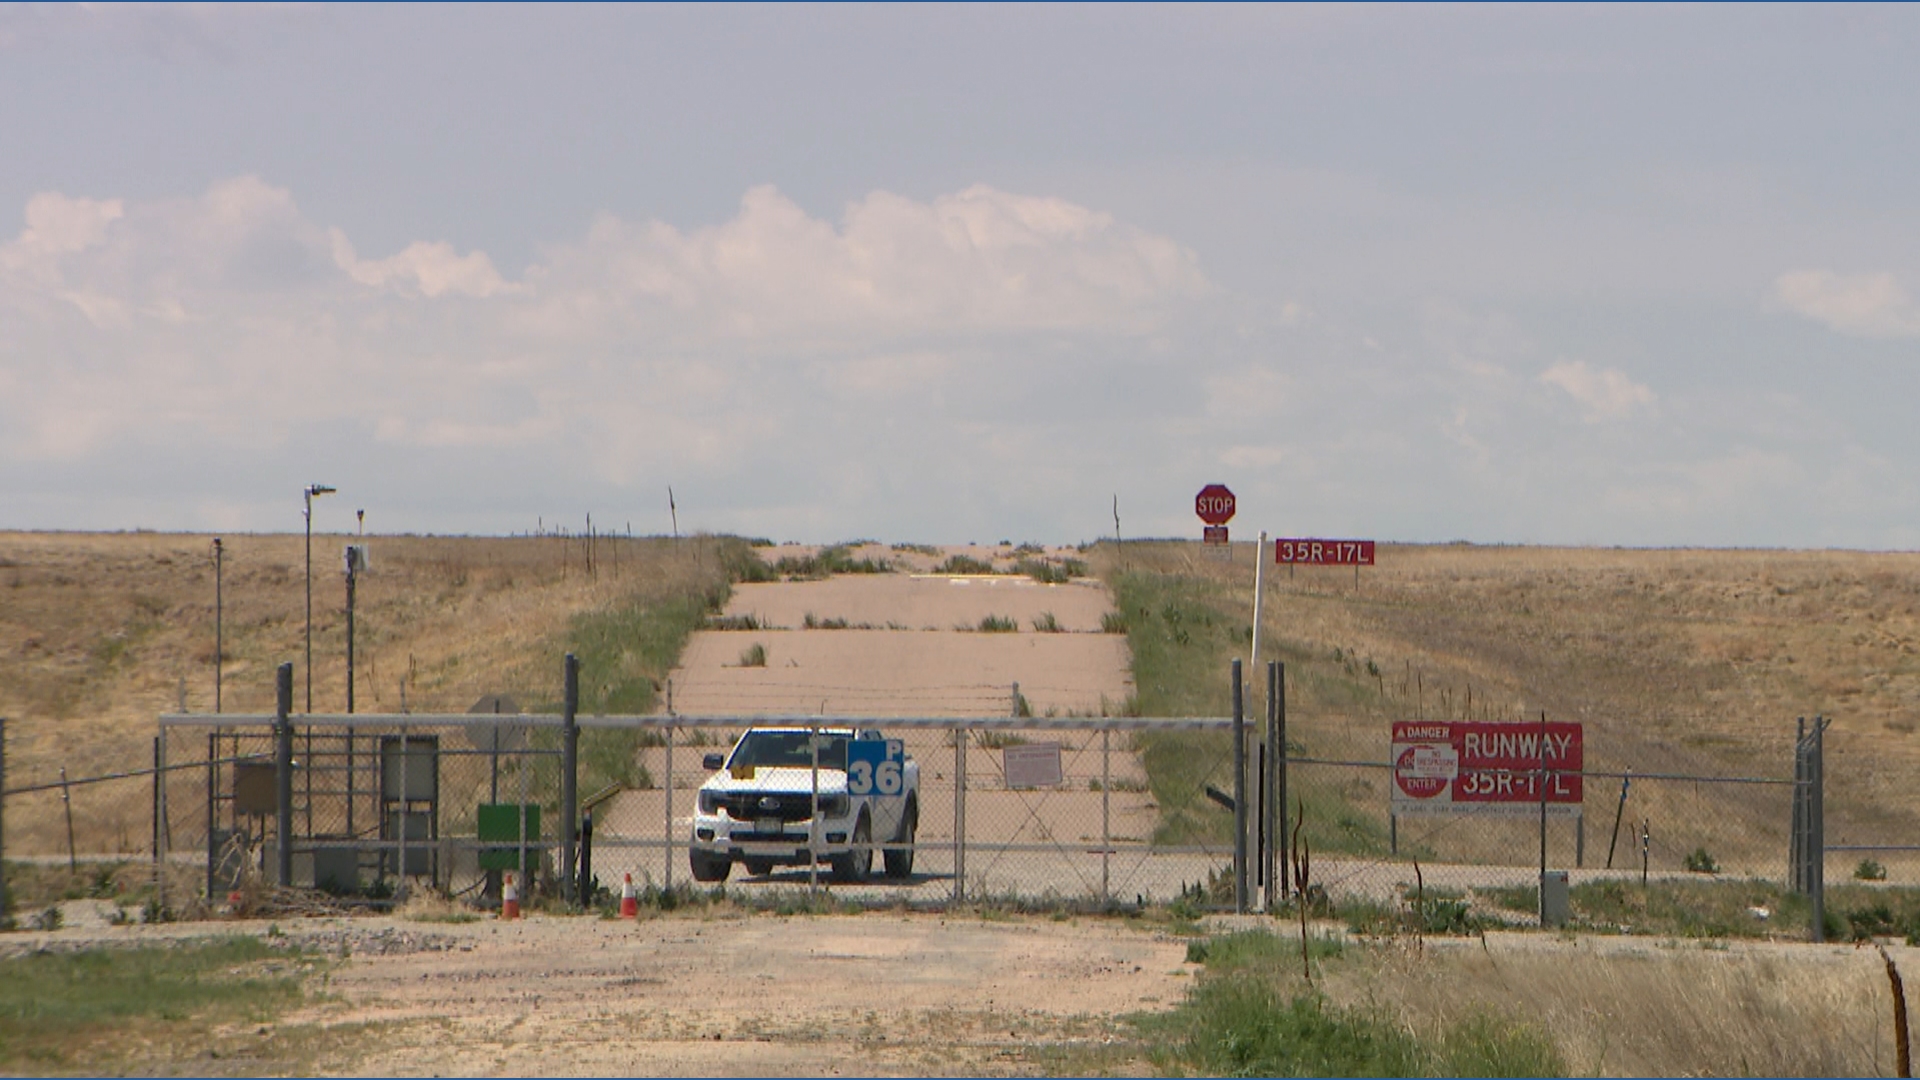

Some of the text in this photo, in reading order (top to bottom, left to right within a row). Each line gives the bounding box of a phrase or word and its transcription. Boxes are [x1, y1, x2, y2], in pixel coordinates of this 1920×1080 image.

[1198, 497, 1233, 514] STOP
[1282, 542, 1370, 563] 35R-17L
[1407, 726, 1450, 739] DANGER
[886, 740, 901, 760] P
[1464, 732, 1572, 759] RUNWAY
[849, 760, 902, 794] 36
[1407, 778, 1437, 789] ENTER
